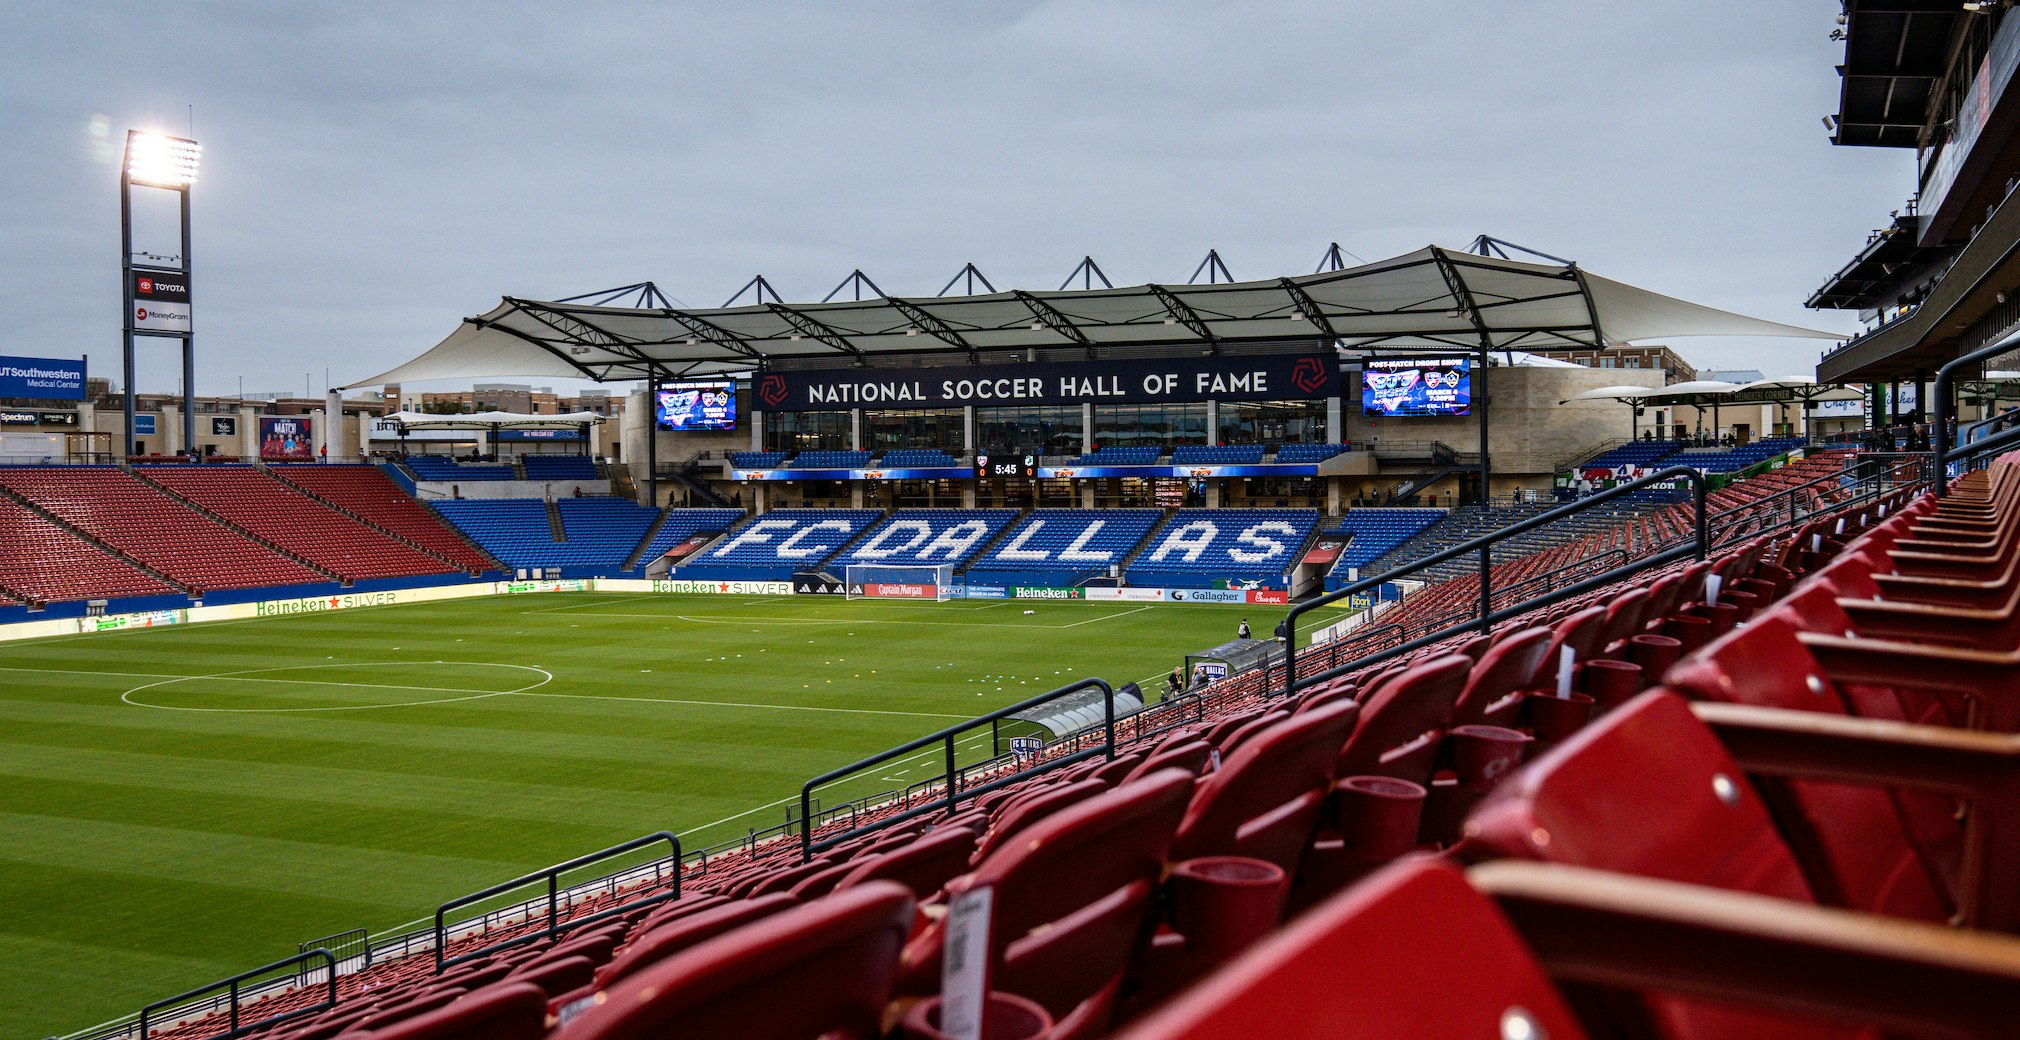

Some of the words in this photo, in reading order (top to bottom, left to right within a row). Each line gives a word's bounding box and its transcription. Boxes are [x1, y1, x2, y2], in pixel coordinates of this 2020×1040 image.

[155, 283, 186, 293] TOYOTA
[149, 312, 189, 320] MoneyGram
[27, 379, 56, 388] Medical
[56, 380, 80, 389] Center
[808, 381, 927, 403] NATIONAL
[942, 377, 1044, 400] SOCCER
[1060, 375, 1126, 397] HALL
[1143, 373, 1178, 394] OF
[1196, 371, 1268, 393] FAME
[1764, 389, 1790, 400] CORNER
[0, 412, 35, 422] Spectrum
[980, 468, 985, 477] 0
[995, 464, 1017, 474] 5:45
[1026, 467, 1033, 476] 0
[713, 519, 851, 558] FC
[851, 519, 1297, 563] DALLAS
[652, 580, 716, 593] Heineken
[733, 583, 789, 594] SILVER
[878, 584, 900, 596] Captain
[900, 584, 922, 596] Morgan
[939, 587, 962, 595] Crest
[1015, 587, 1068, 598] Heineken
[1192, 591, 1239, 602] Gallagher
[256, 598, 326, 617] Heineken
[344, 592, 396, 609] SILVER
[1012, 739, 1020, 748] FC
